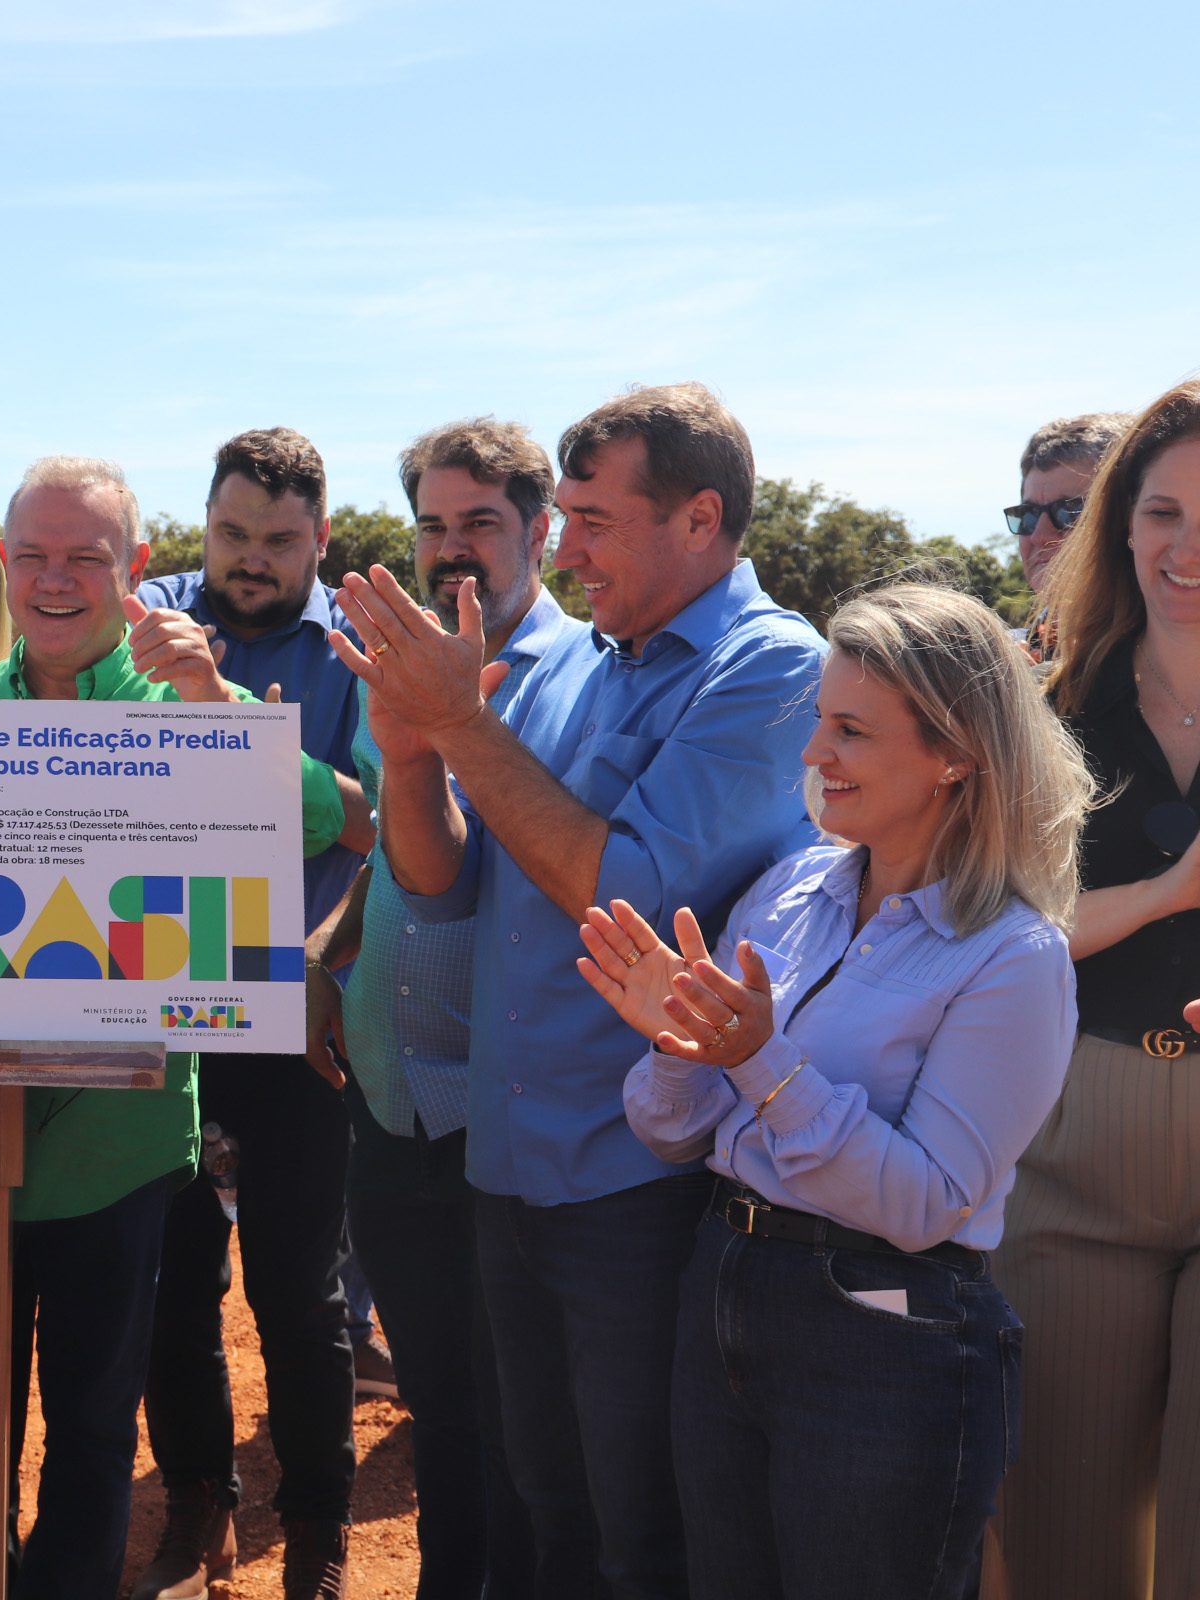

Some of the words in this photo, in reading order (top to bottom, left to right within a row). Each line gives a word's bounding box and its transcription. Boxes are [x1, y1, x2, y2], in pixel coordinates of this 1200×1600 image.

[17, 726, 152, 753] Edificação
[159, 729, 251, 750] Predial
[46, 756, 171, 777] Canarana
[45, 808, 101, 819] Construção
[7, 821, 67, 830] 17.117.425,53
[69, 821, 123, 831] (Dezessete
[126, 822, 167, 830] milhões,
[169, 822, 198, 830] cento
[209, 823, 258, 831] dezessete
[4, 833, 31, 841] cinco
[33, 833, 57, 841] reais
[68, 831, 117, 843] cinquenta
[129, 833, 147, 842] três
[150, 834, 198, 843] centavos)
[11, 856, 36, 864] obra:
[84, 1007, 133, 1015] MINISTÉRIO
[101, 1016, 147, 1024] EDUCAÇÃO
[160, 1005, 252, 1029] BRASIL
